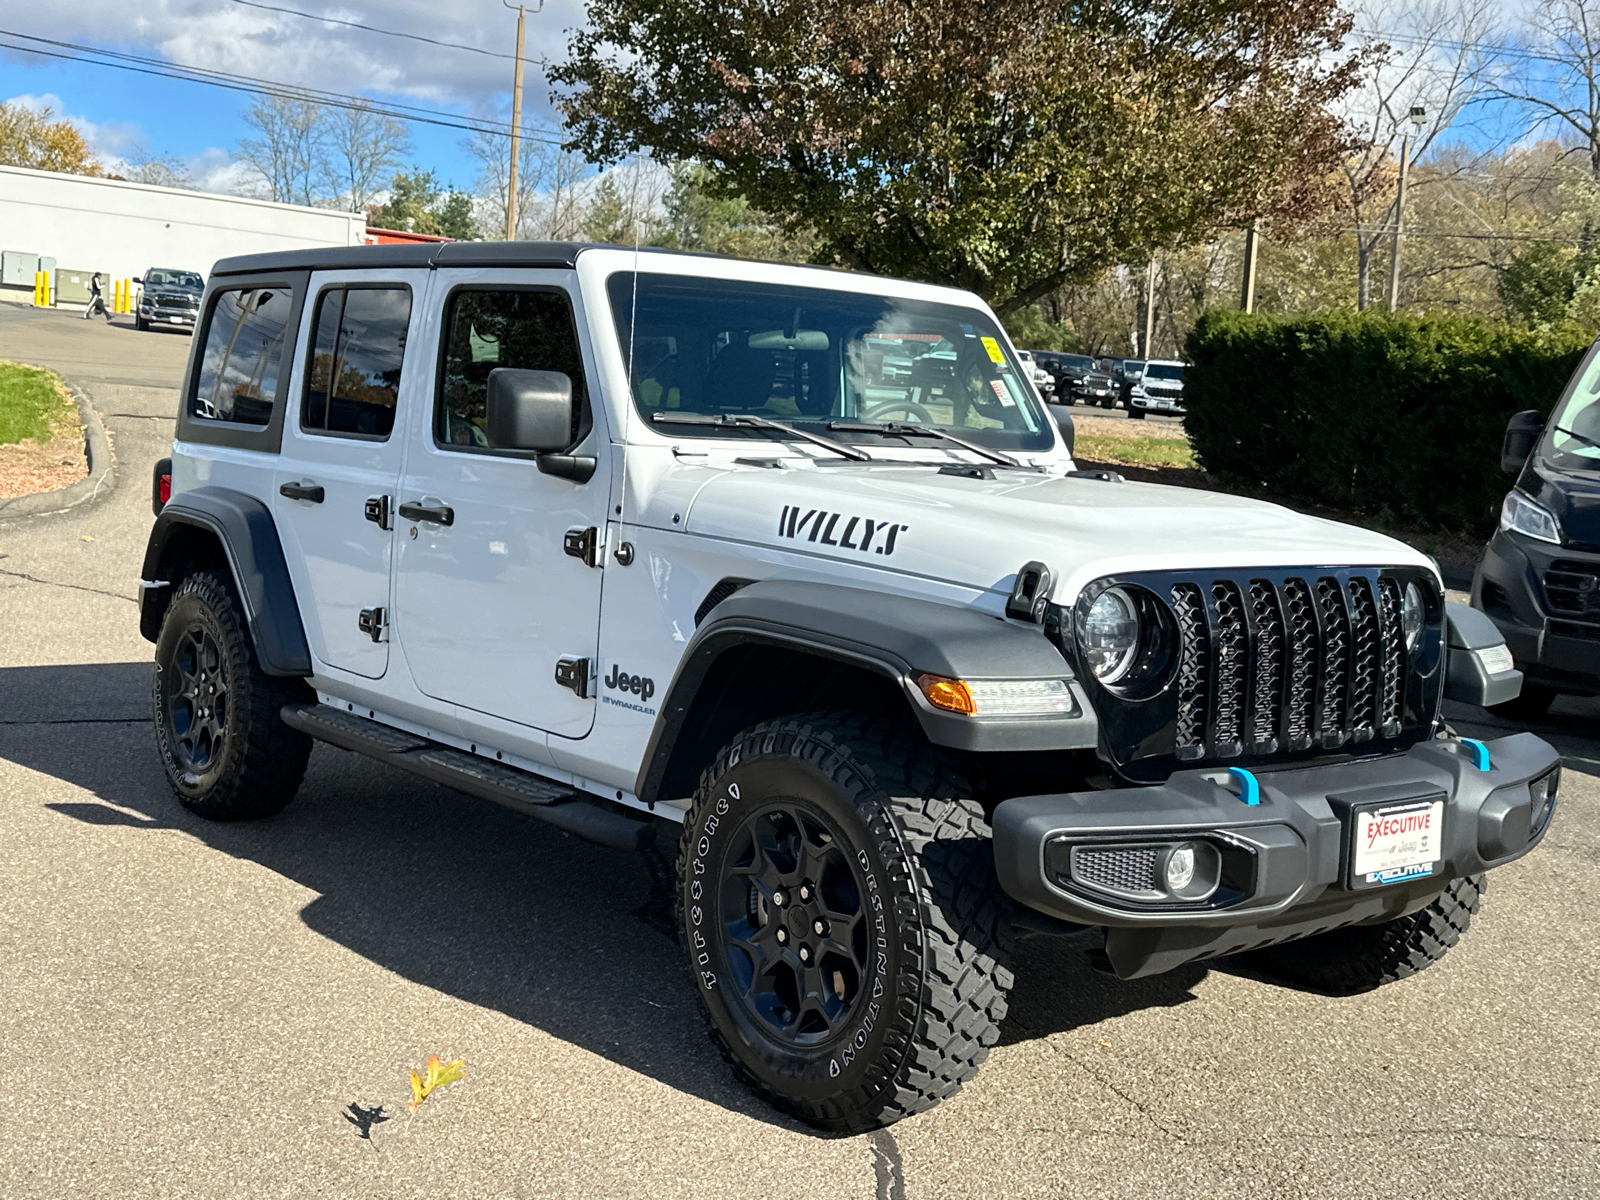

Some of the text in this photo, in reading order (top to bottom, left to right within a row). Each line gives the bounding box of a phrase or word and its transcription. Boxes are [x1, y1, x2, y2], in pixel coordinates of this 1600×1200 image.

[778, 505, 909, 556] WILLYS
[604, 664, 655, 702] Jeep
[610, 698, 656, 717] WRANGLER
[1367, 814, 1431, 849] EXECUTIVE
[1366, 862, 1433, 883] EXECUTIVE
[841, 849, 888, 1067] DESTINATION
